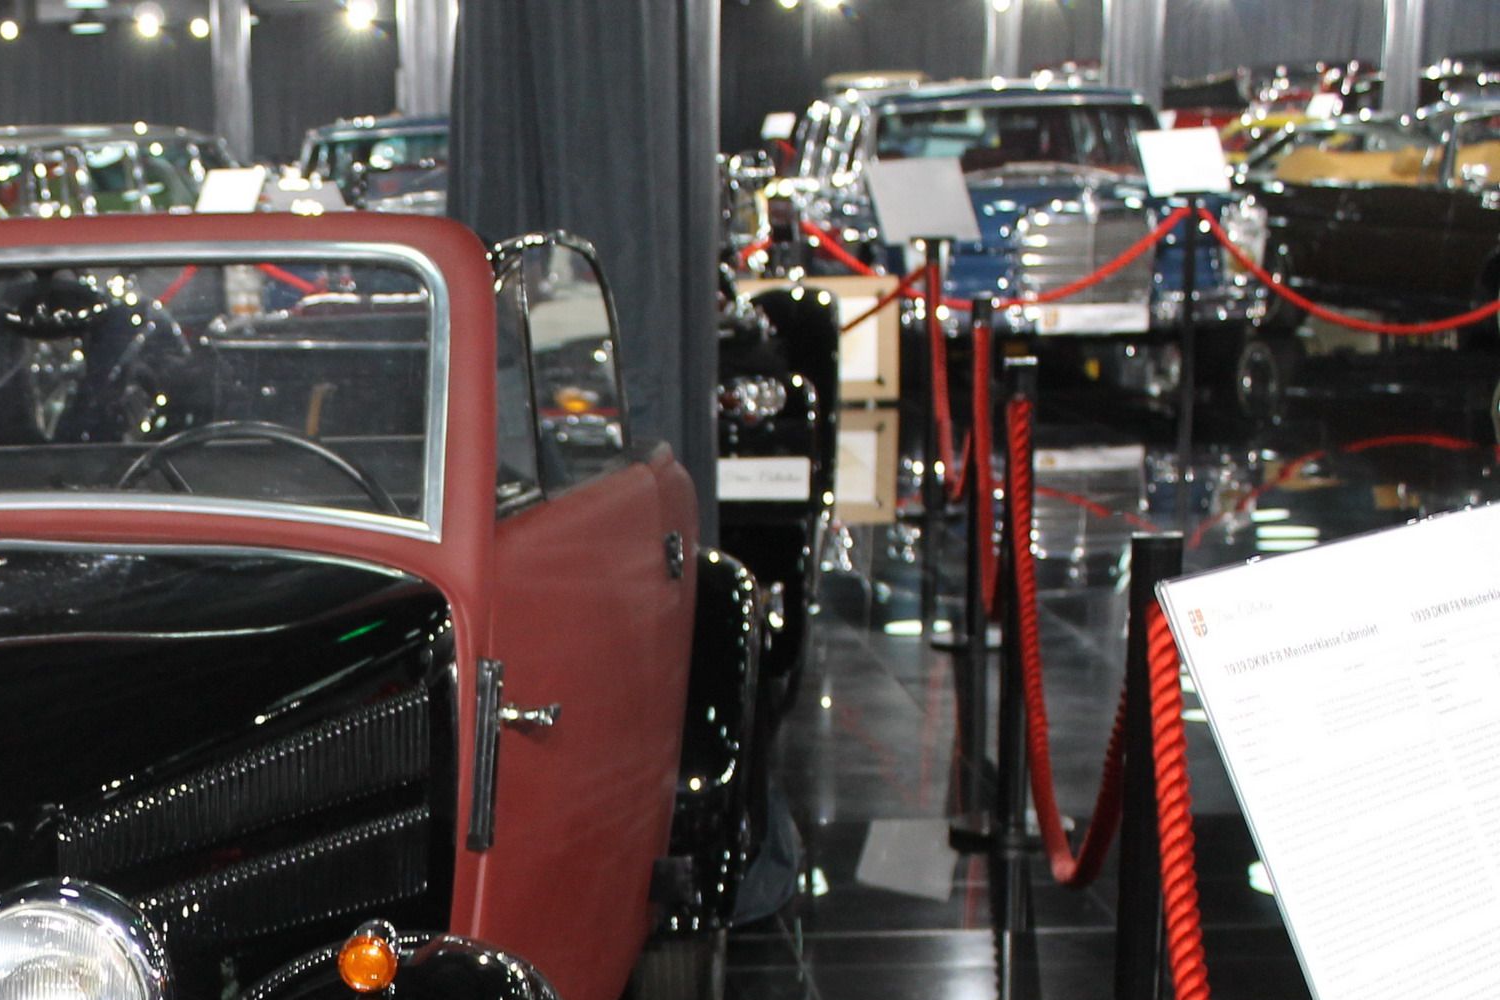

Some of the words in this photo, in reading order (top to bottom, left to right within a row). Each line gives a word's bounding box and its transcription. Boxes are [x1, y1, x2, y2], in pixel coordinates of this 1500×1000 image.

[1411, 608, 1431, 622] 1939
[1431, 602, 1450, 618] DKW
[1224, 660, 1247, 675] 1939
[1247, 652, 1269, 670] DKW
[1269, 649, 1284, 663] F8
[1284, 635, 1340, 659] Meisterklasse
[1341, 623, 1379, 643] Cabriolet
